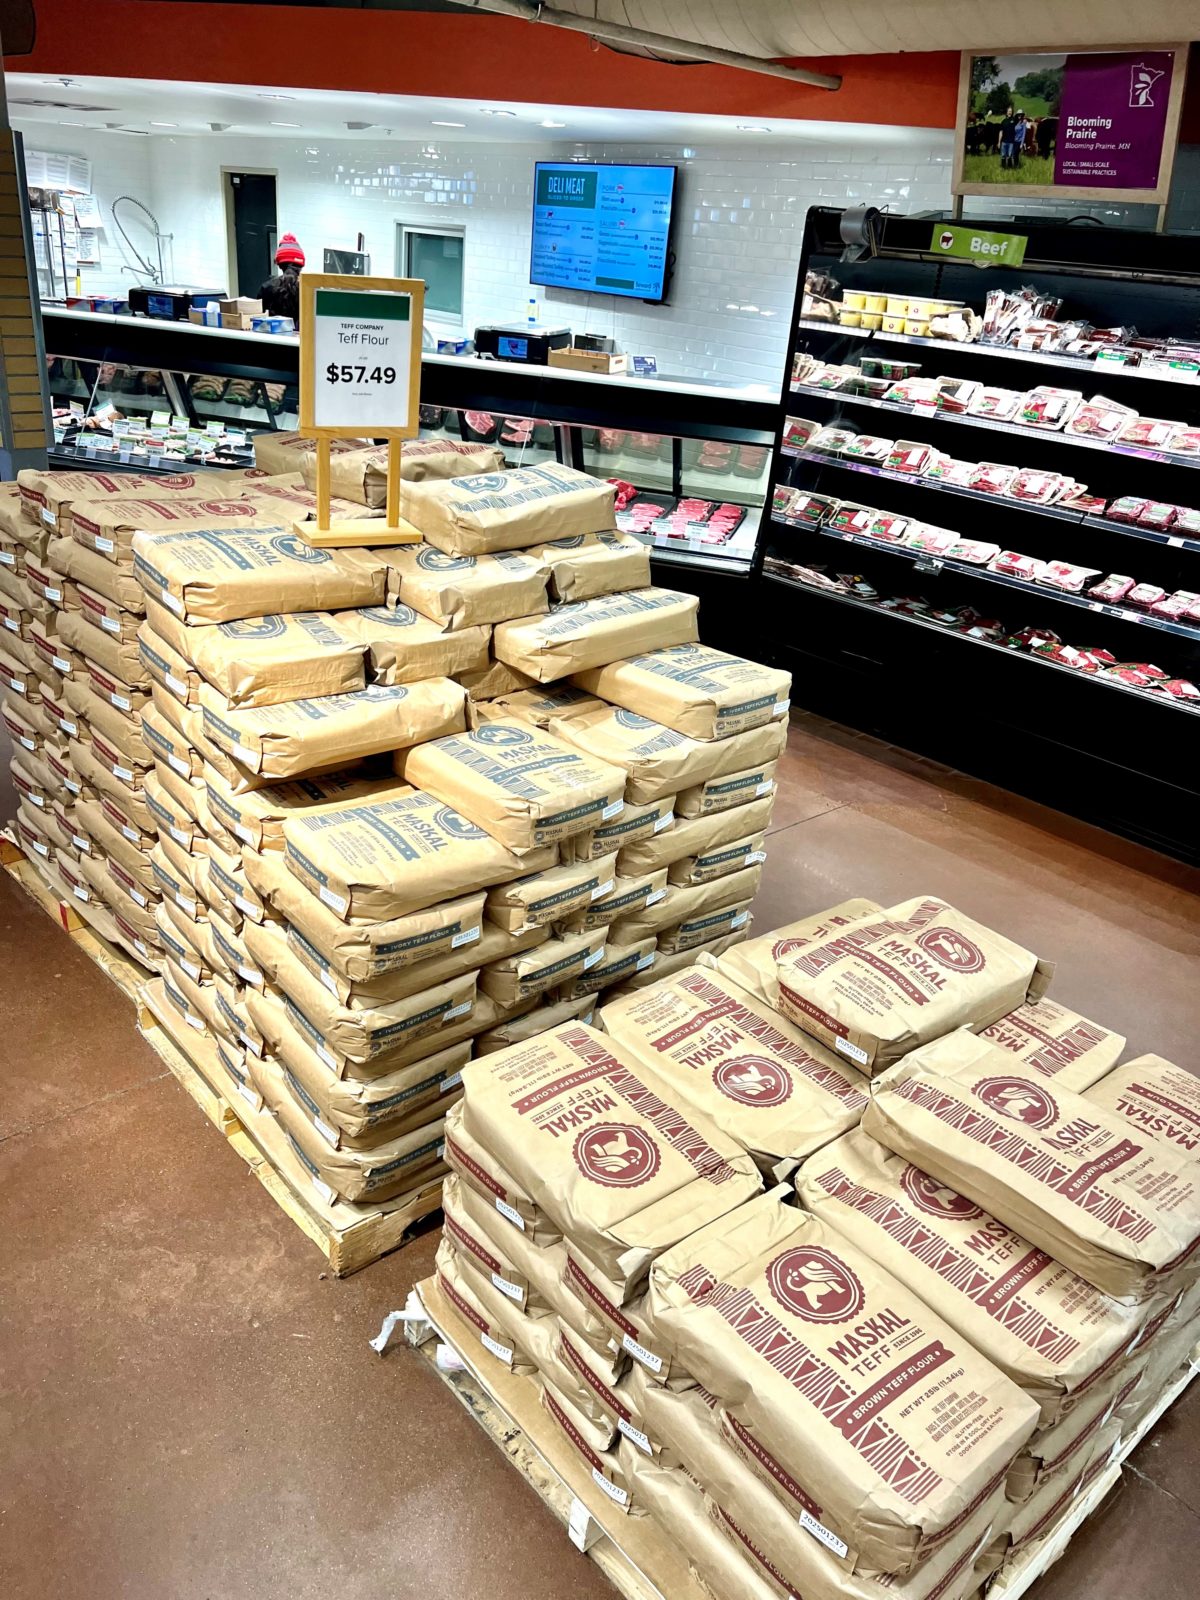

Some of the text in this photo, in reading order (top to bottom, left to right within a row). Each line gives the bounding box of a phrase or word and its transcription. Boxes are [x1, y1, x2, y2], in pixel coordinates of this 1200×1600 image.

[1066, 129, 1097, 139] Prairie
[1068, 116, 1112, 129] Blooming
[548, 176, 585, 194] DELI MEAT
[970, 237, 1008, 256] Beef
[338, 333, 389, 345] Teff Flour
[326, 363, 396, 384] $57.49
[497, 744, 560, 759] MASKAL
[567, 809, 580, 817] TEFF
[580, 803, 598, 814] FLOUR
[389, 817, 414, 833] TEFF
[398, 813, 448, 851] MASKAL
[541, 884, 589, 907] IVORY TEFF FLOUR
[391, 930, 449, 950] IVORY TEFF FLOUR
[878, 947, 910, 968] TEFF
[884, 940, 947, 991] MASKAL
[872, 958, 891, 973] TEFF
[889, 971, 914, 993] FLOUR
[385, 1024, 405, 1033] IVORY
[407, 1018, 420, 1026] TEFF
[421, 1008, 440, 1018] FLOUR
[786, 991, 805, 1007] BROWN
[805, 1005, 820, 1016] TEFF
[820, 1015, 838, 1030] FLOUR
[666, 1028, 689, 1042] FLOUR
[699, 1023, 729, 1046] TEFF
[984, 1027, 1025, 1052] MAS
[995, 1023, 1030, 1044] TEFF
[1013, 1019, 1063, 1050] BROWN TEFF
[679, 1029, 745, 1070] MASKAL
[530, 1064, 608, 1103] BROWN TEFF FLOUR
[546, 1086, 604, 1115] TEFF SINCE
[1146, 1092, 1178, 1109] FLOUR
[538, 1093, 618, 1138] MASKAL
[1116, 1099, 1198, 1150] MASKAL
[467, 1161, 480, 1174] TEFF
[480, 1172, 497, 1189] FLOUR
[1072, 1165, 1099, 1189] BROWN
[463, 1234, 491, 1263] TEFF FLOUR
[963, 1222, 1010, 1256] MAS
[987, 1236, 1021, 1265] TEFF
[993, 1258, 1039, 1300] BROWN TEFF
[1035, 1285, 1047, 1296] NET
[1046, 1278, 1056, 1288] WT
[570, 1260, 627, 1329] BROWN TEFF FLOUR
[468, 1310, 481, 1324] FLOUR
[827, 1308, 911, 1366] MASKAL
[626, 1338, 659, 1363] 202501237
[850, 1335, 911, 1377] TEFF SINCE
[567, 1345, 619, 1409] BROWN TEFF FLOUR
[852, 1353, 936, 1420] BROWN TEFF FLOUR
[899, 1368, 965, 1419] NET WT 25lb (11.34kg)
[562, 1418, 593, 1459] TEFF FLOUR
[620, 1421, 646, 1441] 2025012
[955, 1414, 984, 1439] GLUTEN-FREE
[733, 1420, 759, 1456] BROWN
[759, 1454, 779, 1475] TEFF
[778, 1473, 805, 1501] FLOUR
[945, 1442, 960, 1456] STORE
[804, 1514, 844, 1548] 202501237
